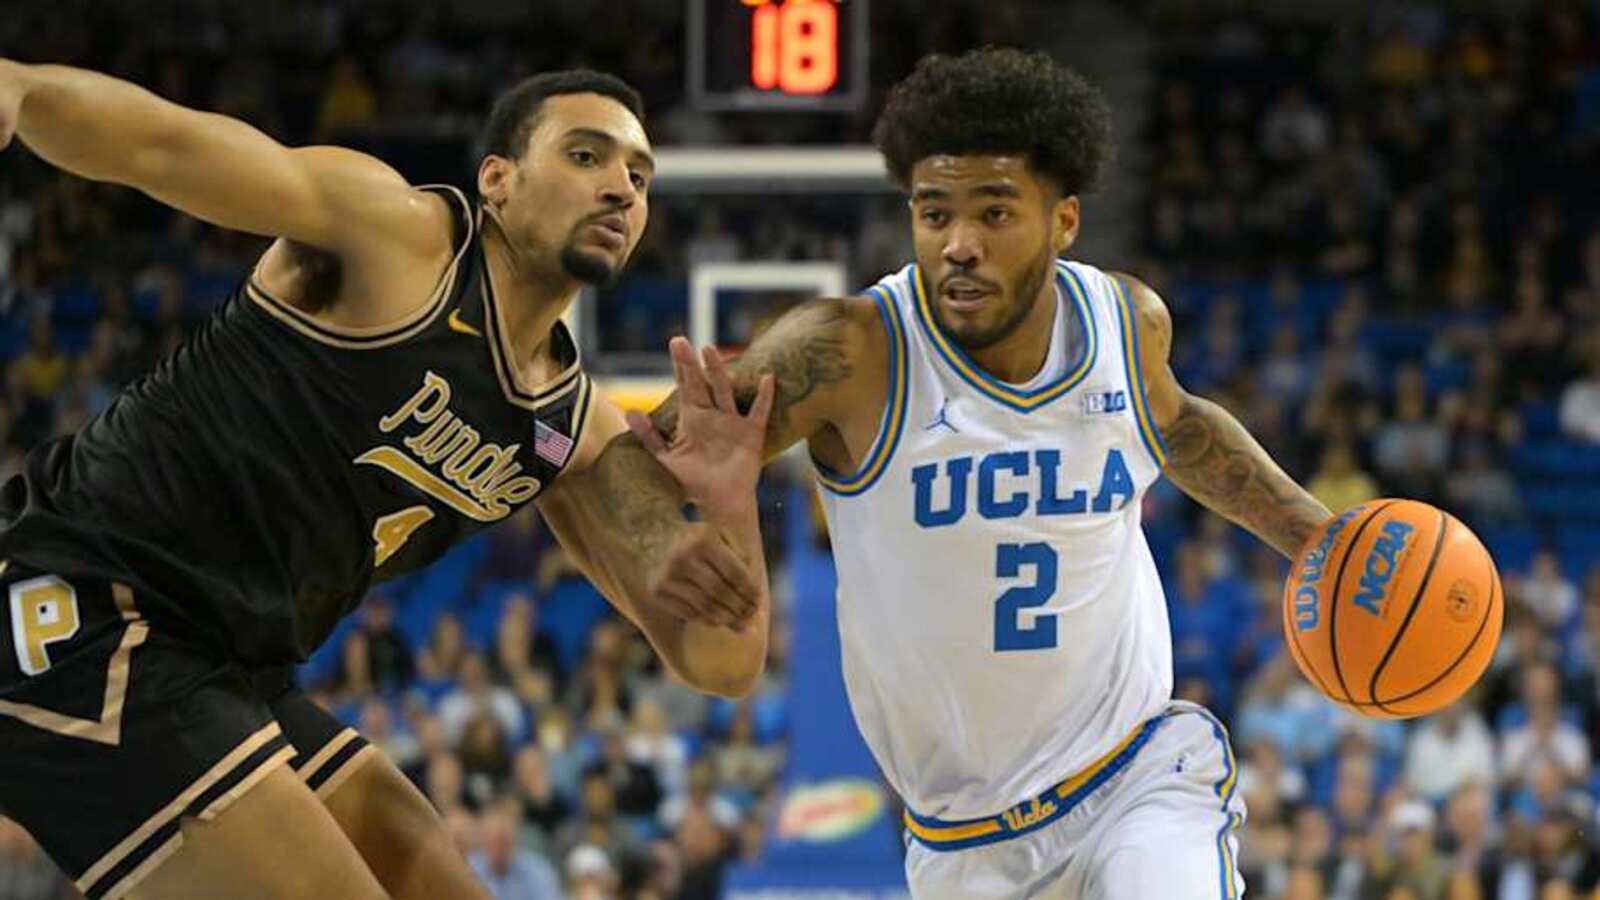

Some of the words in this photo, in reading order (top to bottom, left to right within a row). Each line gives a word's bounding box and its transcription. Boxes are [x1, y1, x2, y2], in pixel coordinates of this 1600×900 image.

[752, 3, 839, 94] 18
[911, 449, 1135, 529] UCLA
[373, 505, 435, 568] 4
[1353, 520, 1415, 616] NCAA
[9, 575, 80, 676] P
[994, 541, 1058, 652] 2
